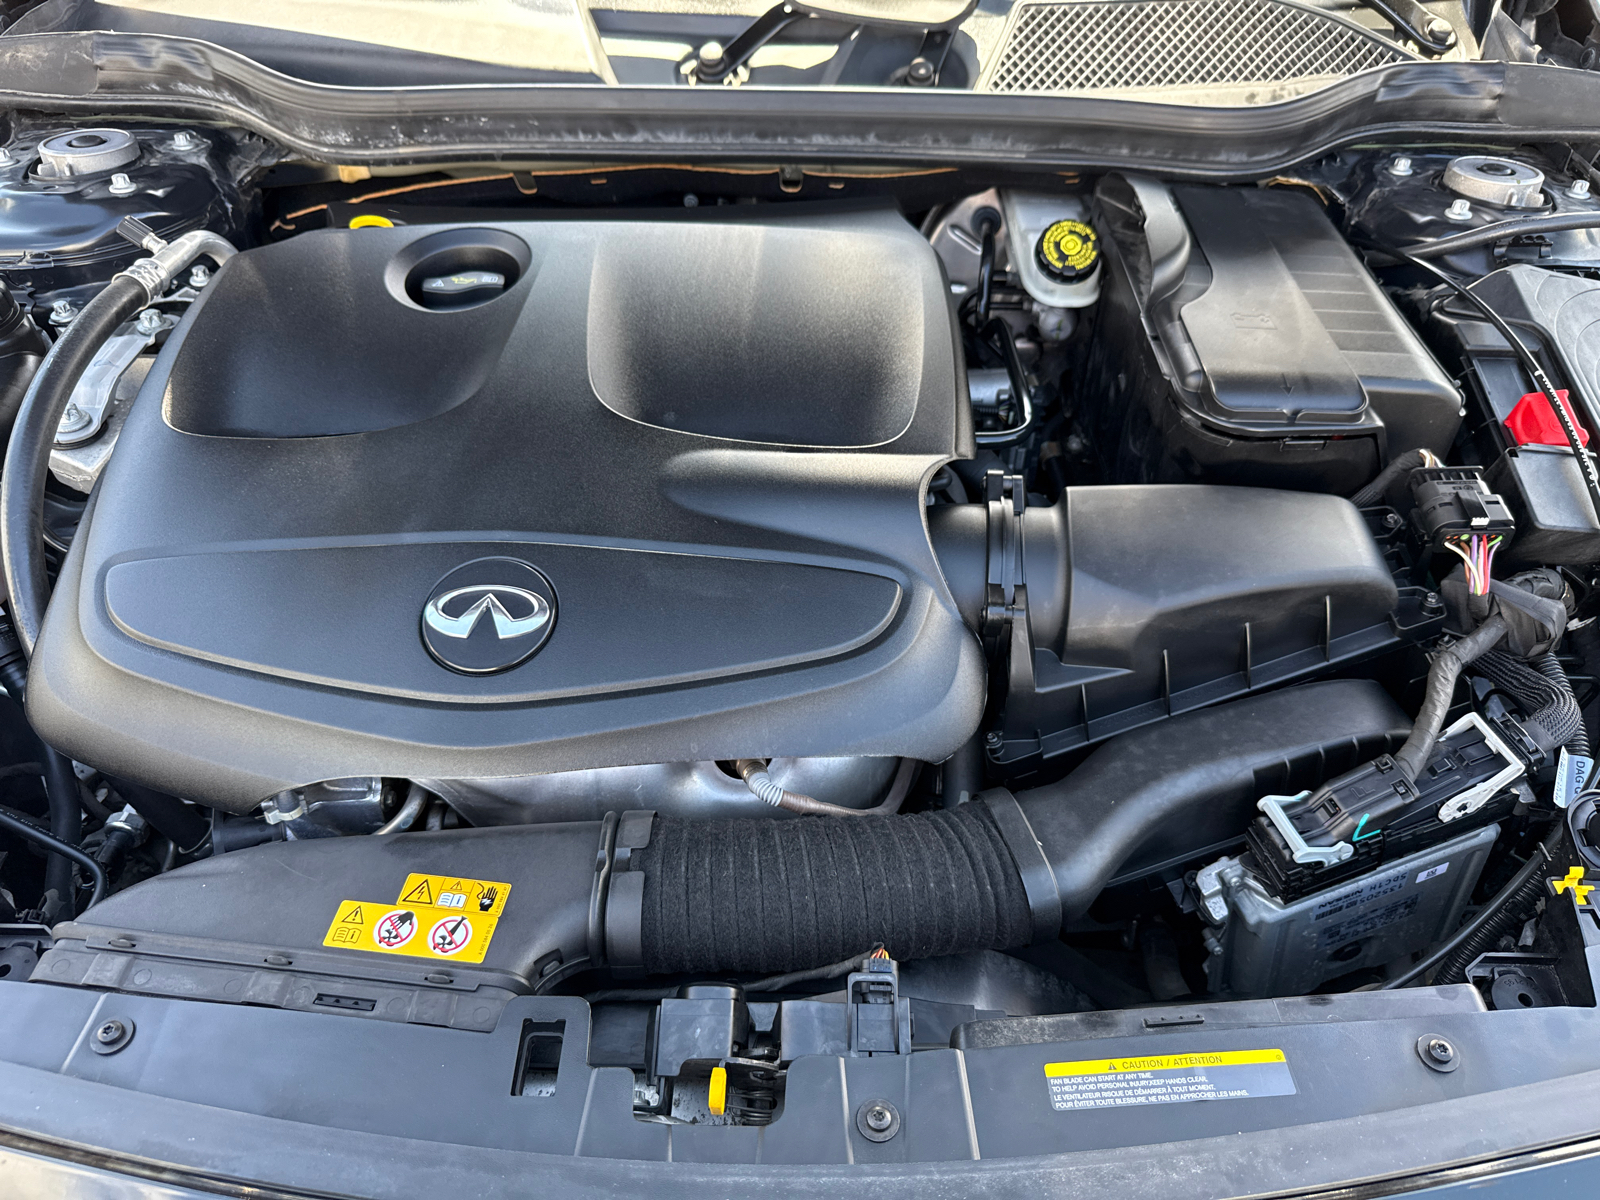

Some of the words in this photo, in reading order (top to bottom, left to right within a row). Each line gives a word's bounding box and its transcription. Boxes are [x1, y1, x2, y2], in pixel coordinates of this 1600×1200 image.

[1574, 760, 1586, 784] DAG
[1318, 888, 1364, 909] NISSAN
[1122, 1059, 1163, 1069] CAUTION
[1174, 1056, 1222, 1066] ATTENTION
[1097, 1081, 1129, 1090] PERSONAL
[1062, 1092, 1101, 1100] VENTILATEUR
[1134, 1087, 1167, 1096] DÉMARRER
[1075, 1099, 1095, 1108] ÉVITER
[1116, 1097, 1148, 1105] BLESSURE,
[1180, 1091, 1216, 1100] APPROCHER
